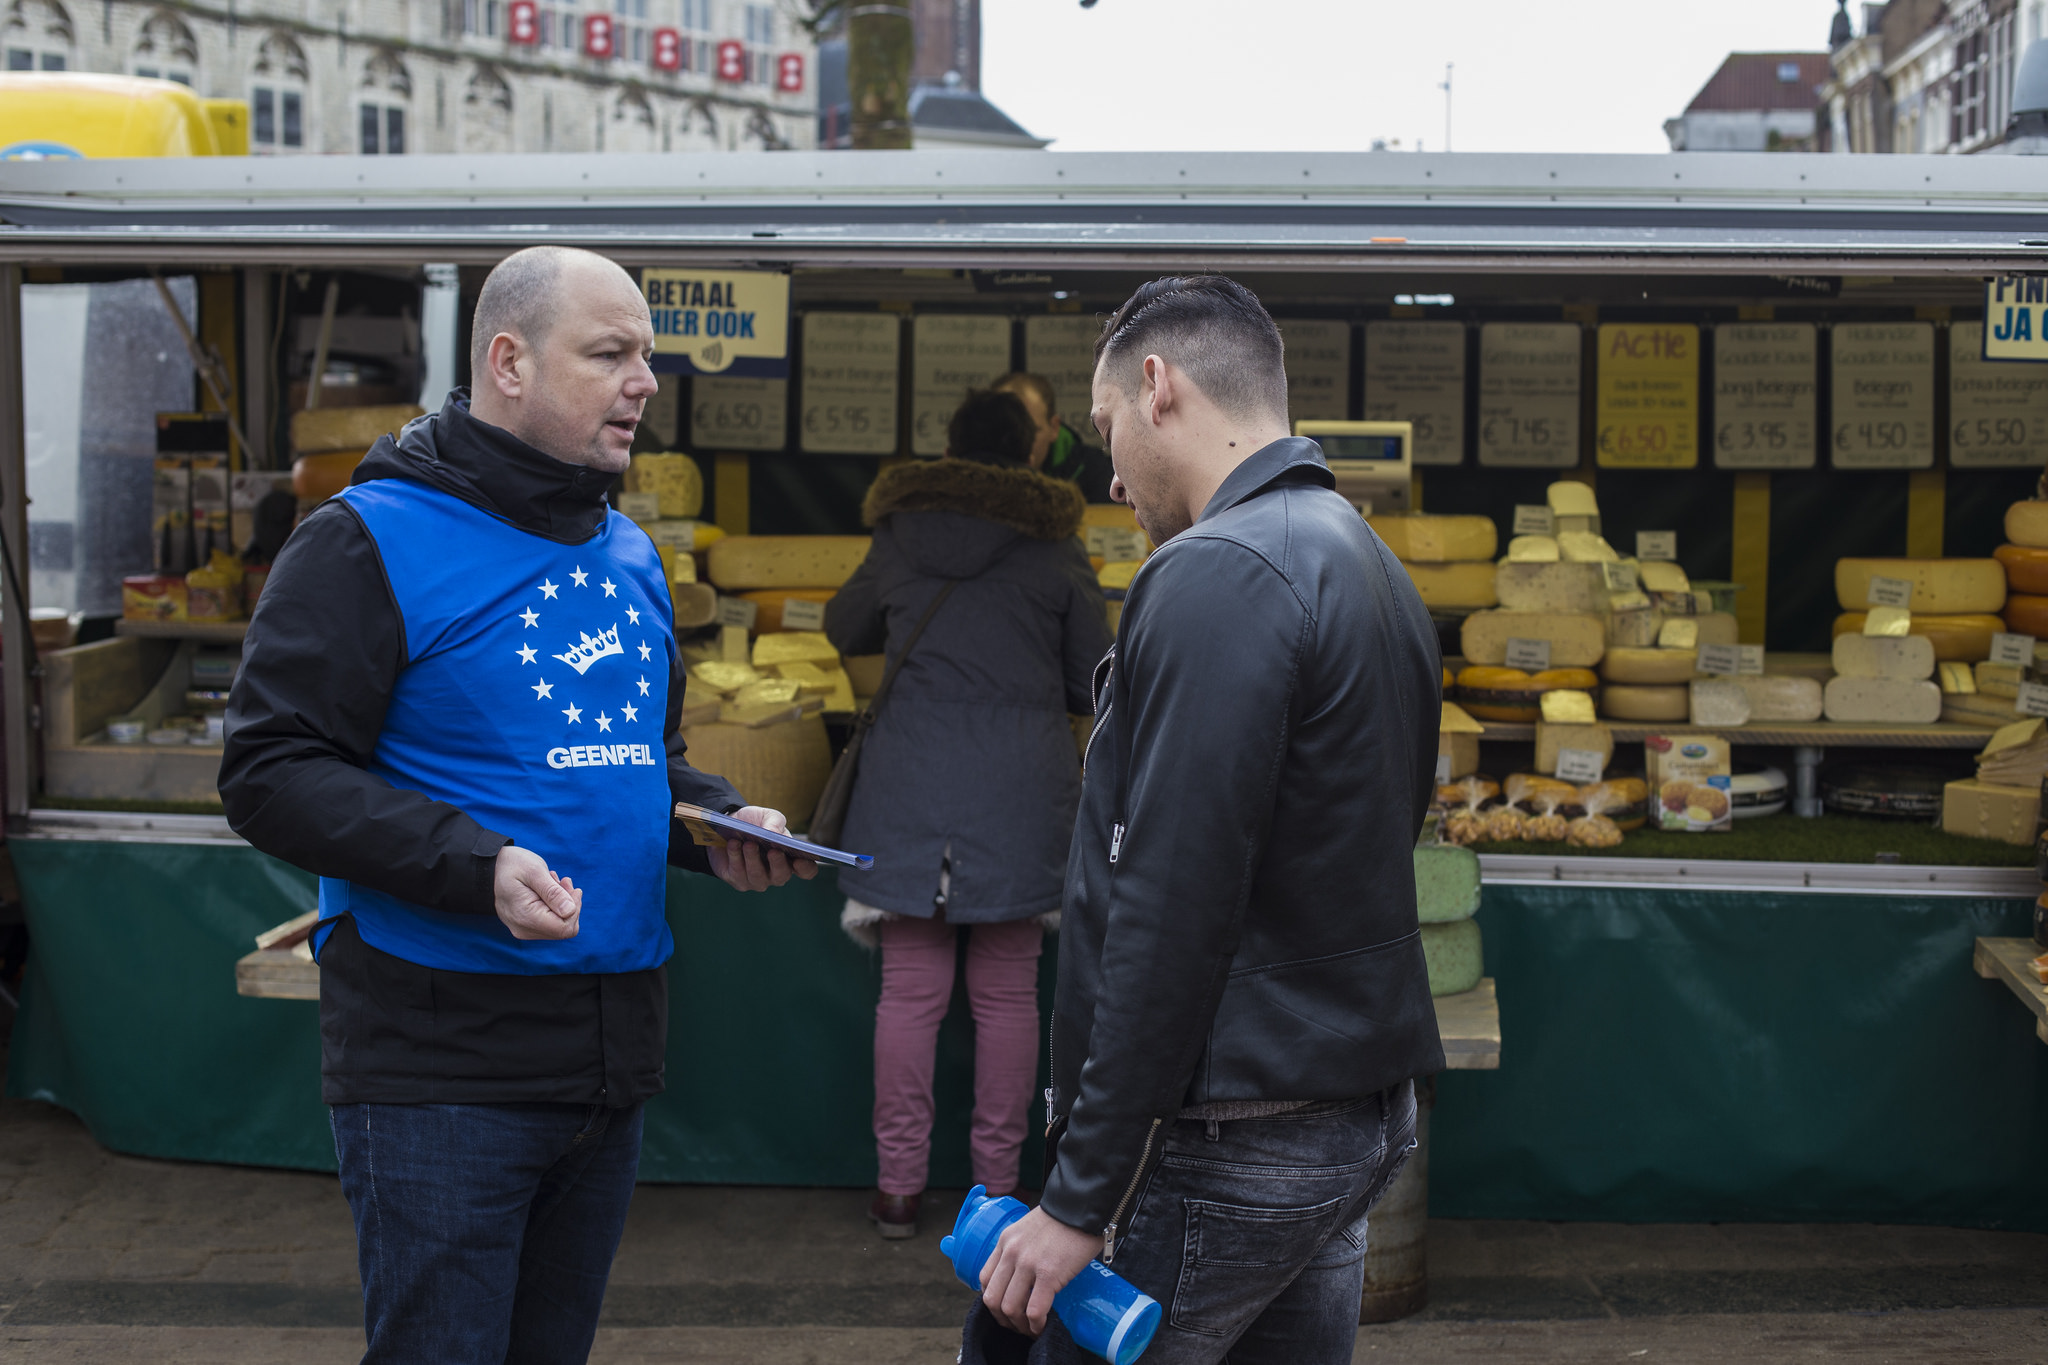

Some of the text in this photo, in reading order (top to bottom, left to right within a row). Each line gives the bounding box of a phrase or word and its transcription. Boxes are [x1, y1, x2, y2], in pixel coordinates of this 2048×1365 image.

[648, 280, 736, 307] BETAAL
[1996, 277, 2048, 303] PIN
[650, 309, 755, 338] HIER OOK
[1994, 307, 2032, 341] JA
[546, 744, 656, 769] GEENPEIL
